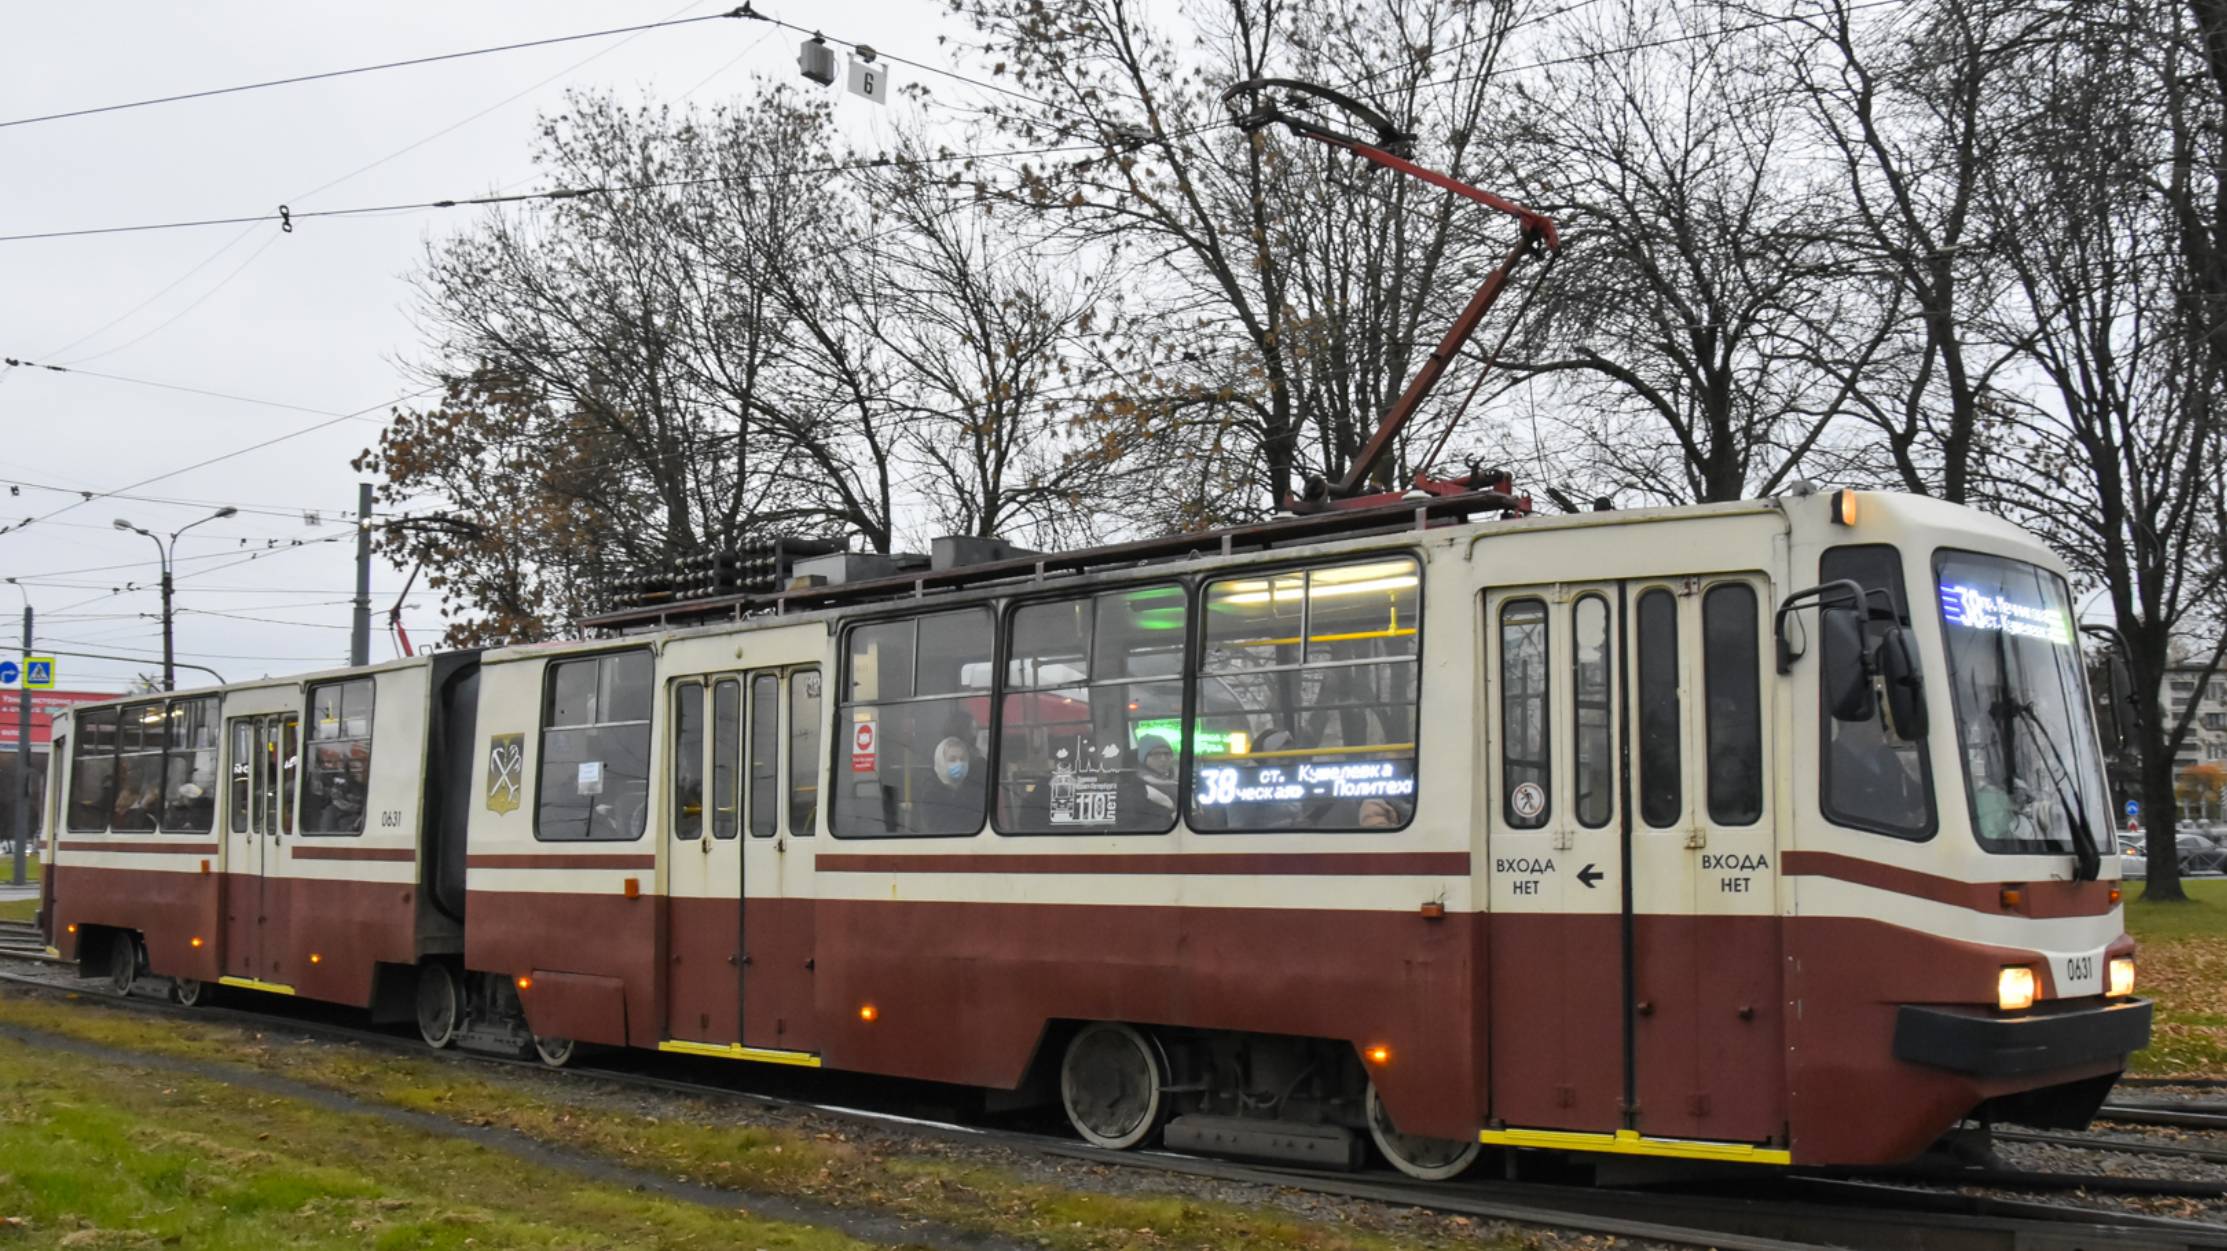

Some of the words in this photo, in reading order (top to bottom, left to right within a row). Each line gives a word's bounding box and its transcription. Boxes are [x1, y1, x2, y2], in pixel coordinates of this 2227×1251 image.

[863, 71, 875, 96] 6
[1259, 769, 1285, 784] ст.
[1198, 768, 1238, 805] 38
[1076, 792, 1105, 822] 110
[381, 810, 401, 828] 0631
[1496, 858, 1556, 875] ВХОДА
[1701, 854, 1769, 872] ВХОДА
[1513, 880, 1540, 895] НЕТ
[1720, 877, 1752, 893] НЕТ
[2067, 955, 2093, 981] 0631
